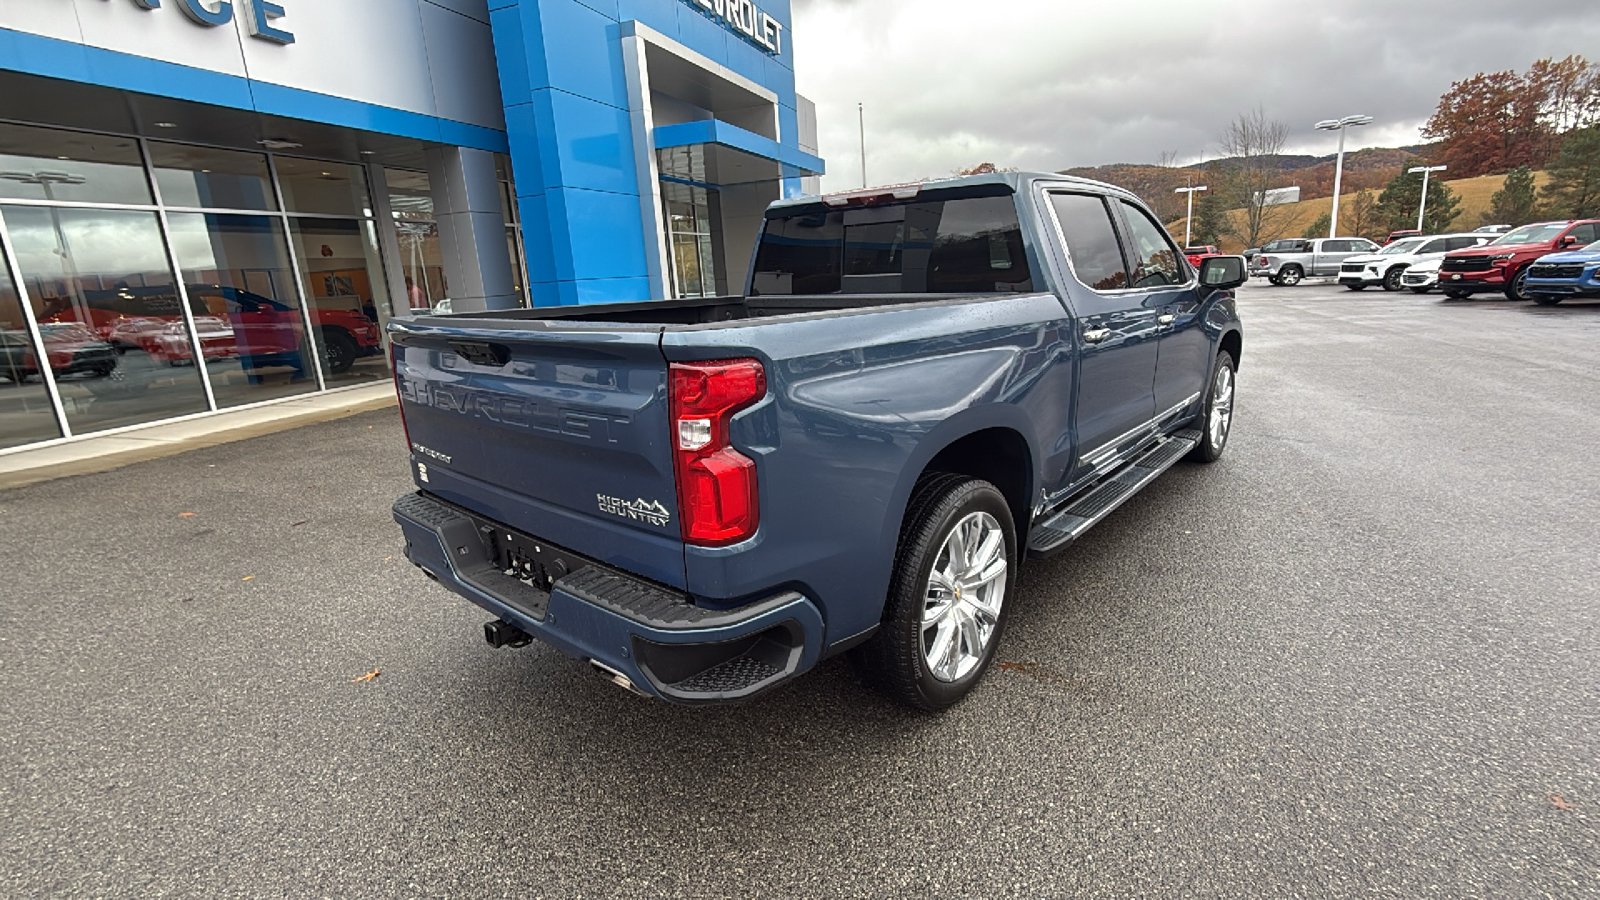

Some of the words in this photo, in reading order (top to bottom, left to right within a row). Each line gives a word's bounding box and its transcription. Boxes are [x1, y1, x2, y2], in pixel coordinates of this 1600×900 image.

[401, 379, 630, 443] CHEVROLET
[596, 493, 631, 508] HIGH
[598, 502, 670, 527] COUNTRY
[911, 618, 922, 680] BRIDGESTONE
